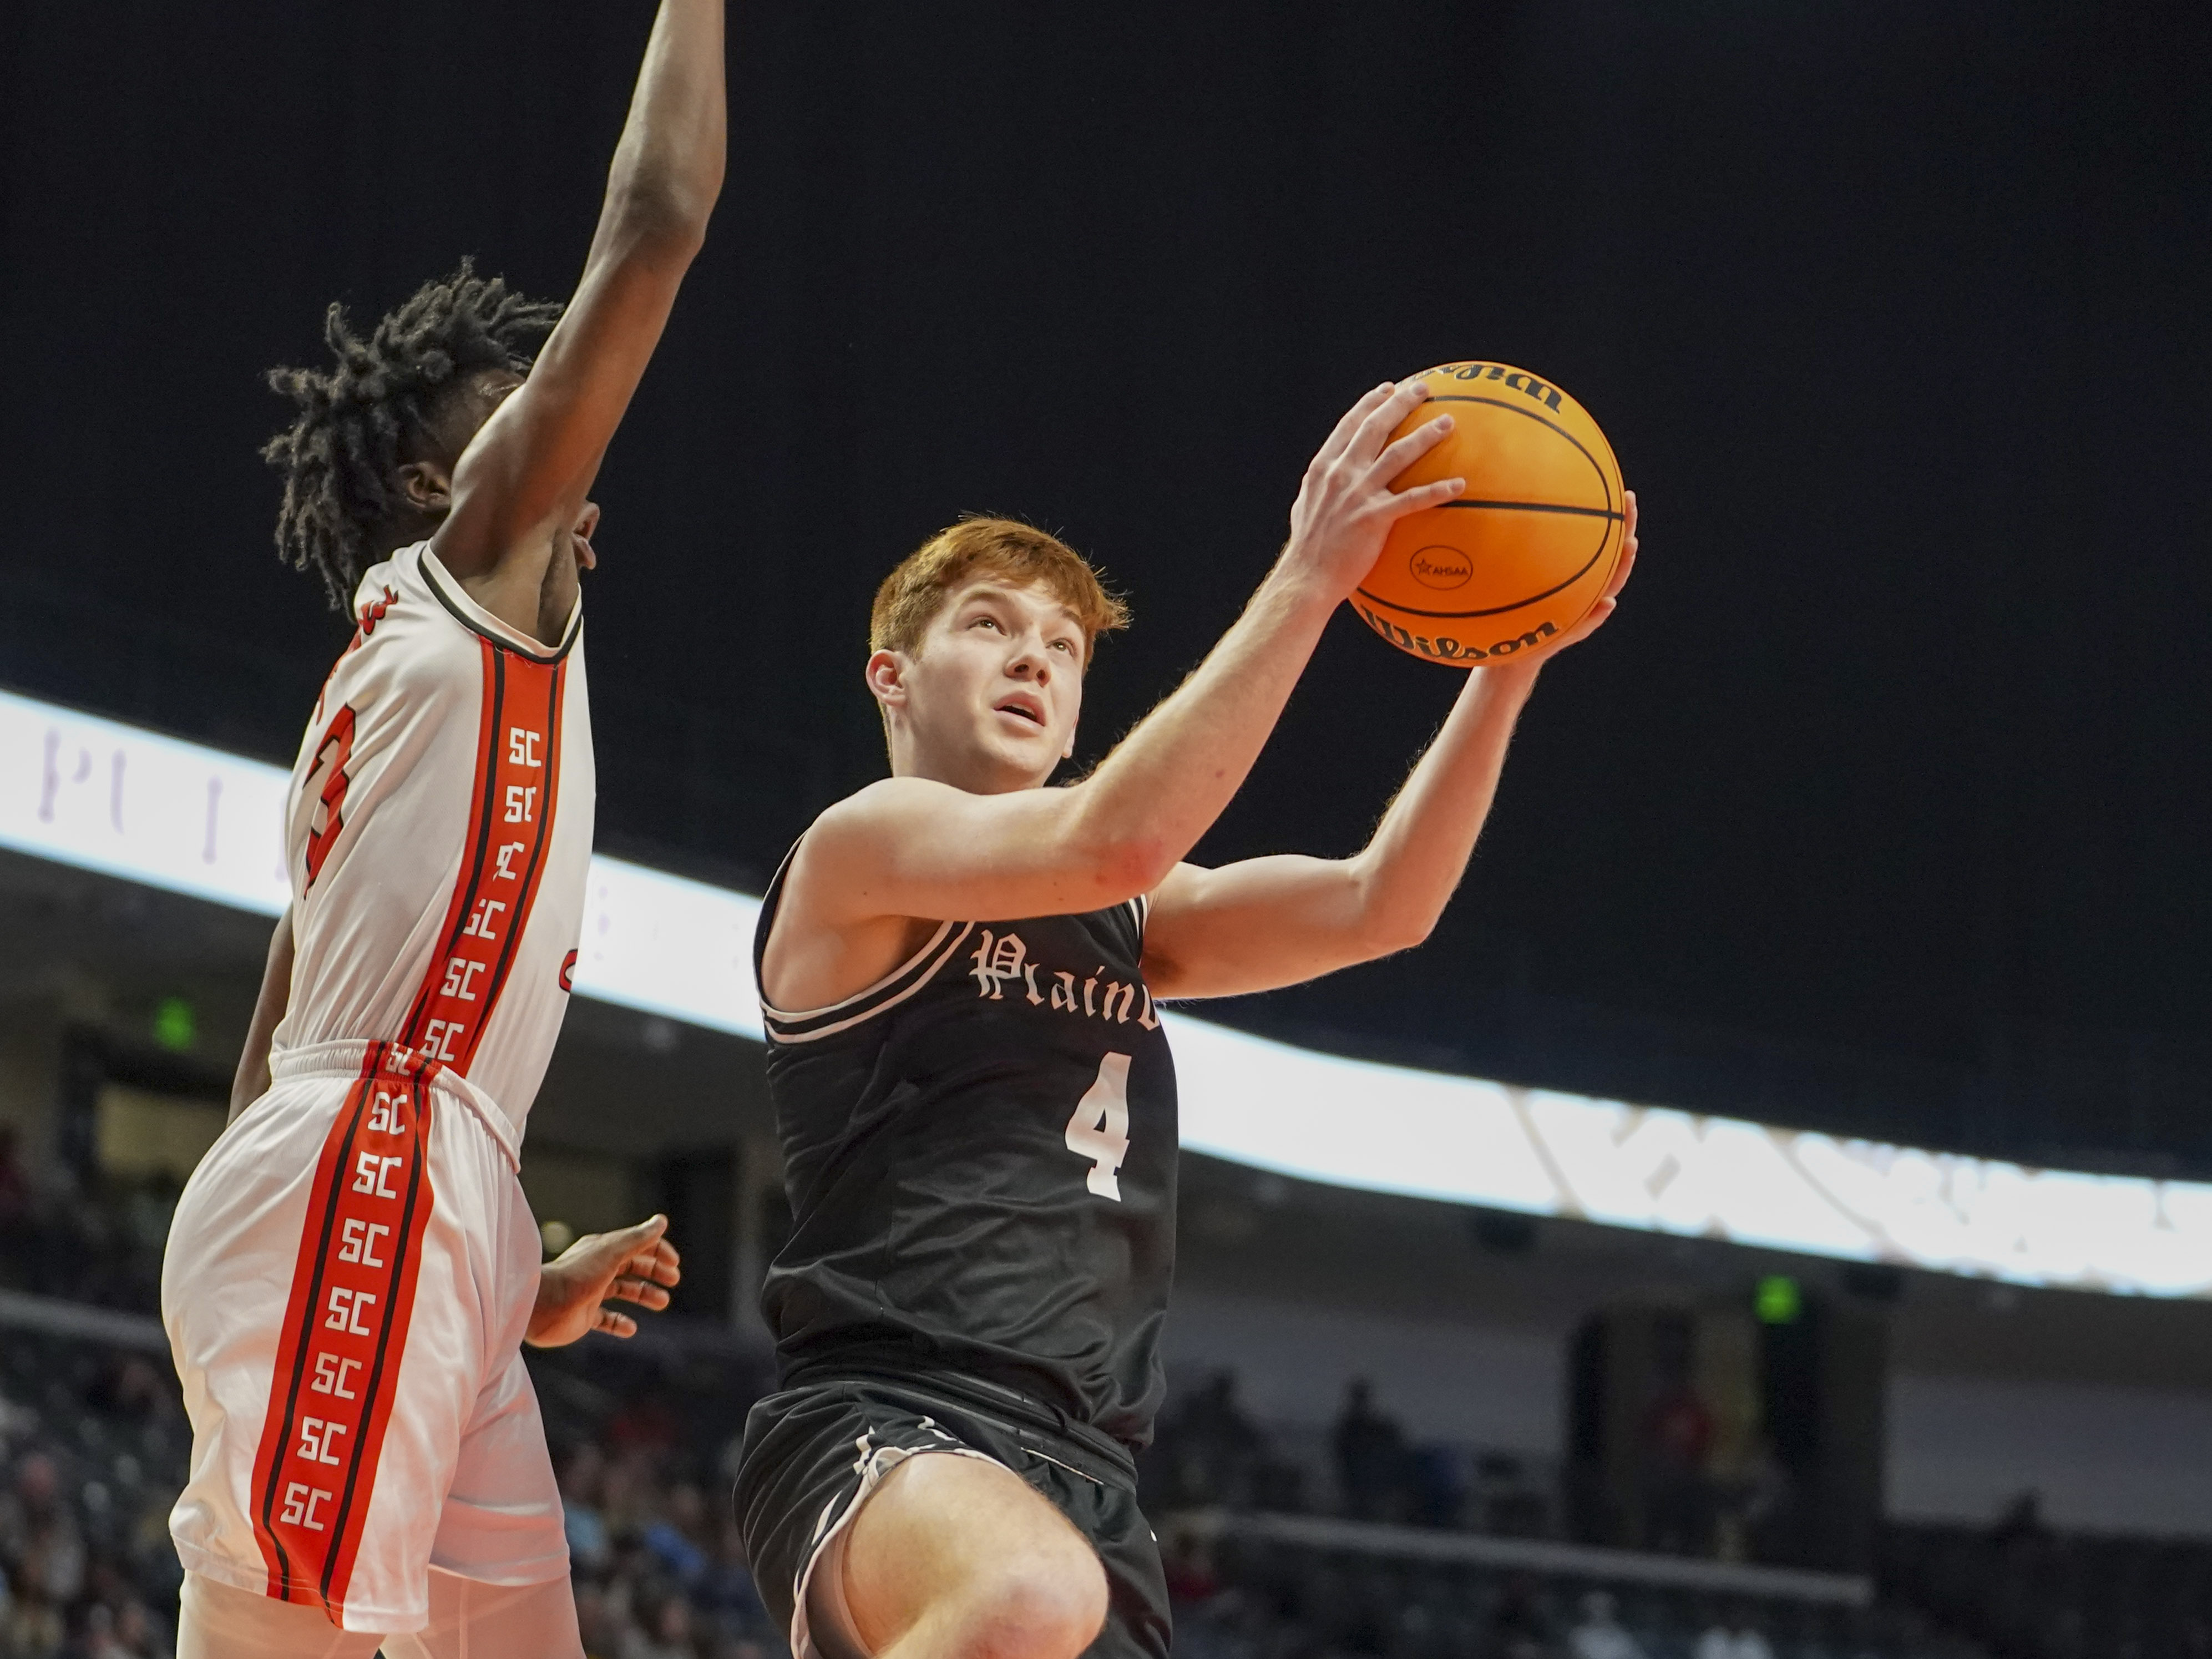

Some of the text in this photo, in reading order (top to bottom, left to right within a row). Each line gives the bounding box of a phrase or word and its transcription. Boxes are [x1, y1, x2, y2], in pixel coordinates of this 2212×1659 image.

[1360, 604, 1560, 661] Wilson
[509, 727, 542, 768] SC
[440, 958, 486, 1001] SC
[385, 1042, 414, 1076] SC
[419, 1019, 464, 1061] SC
[367, 1091, 408, 1135] SC
[1065, 1051, 1132, 1202] 4
[352, 1150, 402, 1200] SC
[338, 1218, 389, 1268] SC
[325, 1286, 376, 1336] SC
[311, 1352, 362, 1400] SC
[297, 1416, 347, 1466] SC
[280, 1481, 332, 1531] SC
